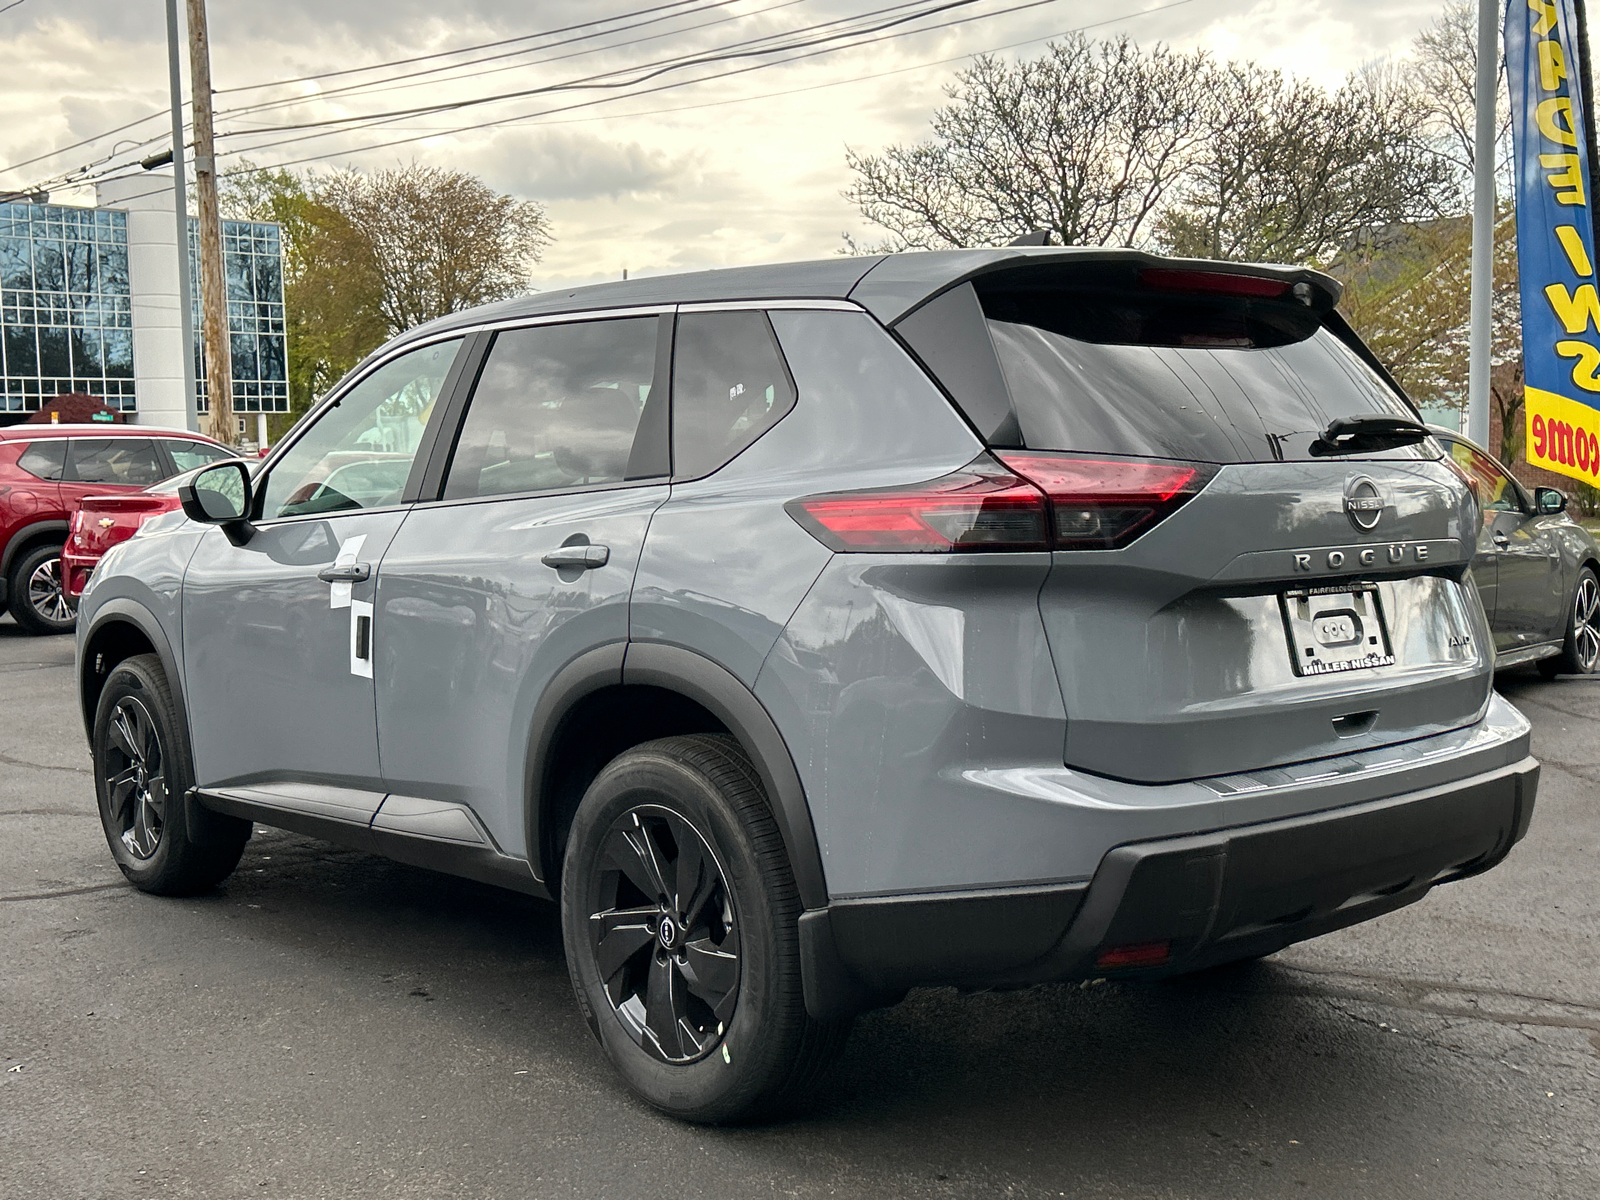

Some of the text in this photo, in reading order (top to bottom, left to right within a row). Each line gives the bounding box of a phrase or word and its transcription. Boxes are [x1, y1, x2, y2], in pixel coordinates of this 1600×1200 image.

[1293, 543, 1429, 571] ROGUE
[1302, 655, 1395, 676] MILLER NISSAN
